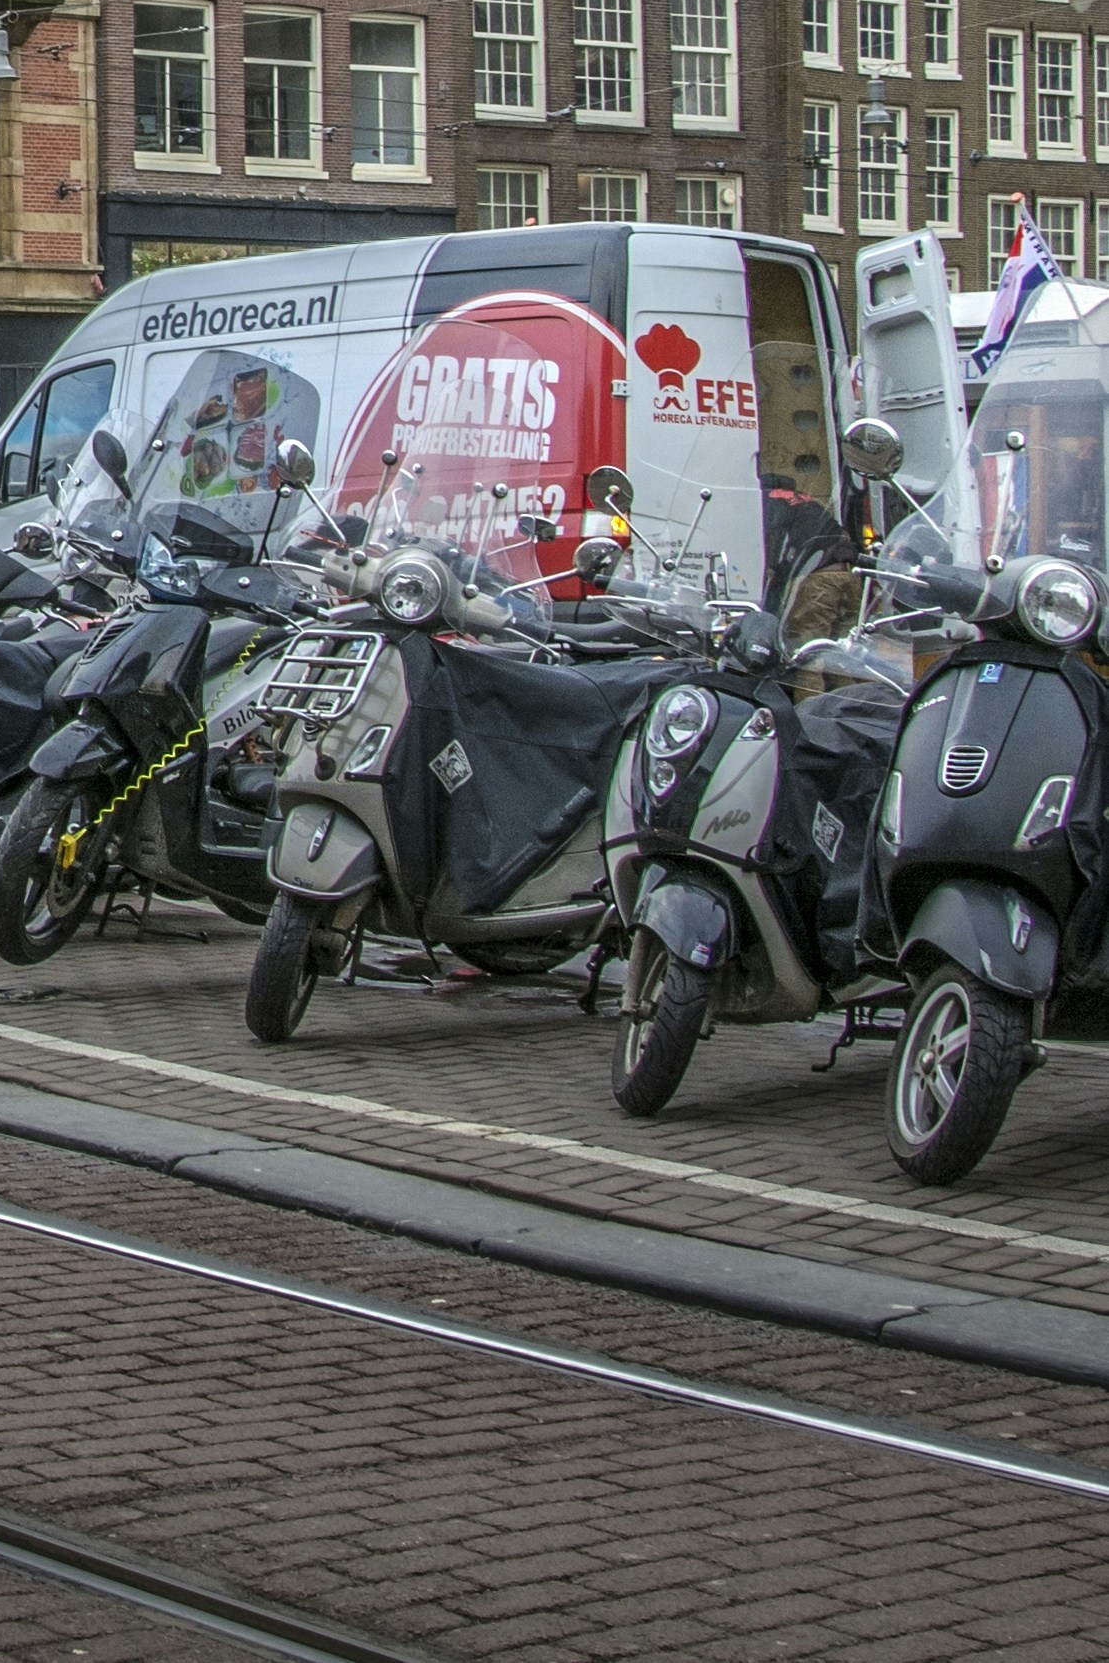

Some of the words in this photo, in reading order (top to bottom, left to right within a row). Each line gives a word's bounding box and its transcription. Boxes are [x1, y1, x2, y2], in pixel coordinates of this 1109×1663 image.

[143, 285, 339, 342] efehoreca.nl
[396, 354, 560, 430] GRATIS
[695, 378, 756, 418] EFE
[653, 412, 693, 425] HORECA
[392, 422, 552, 462] PROEFBESTELLING
